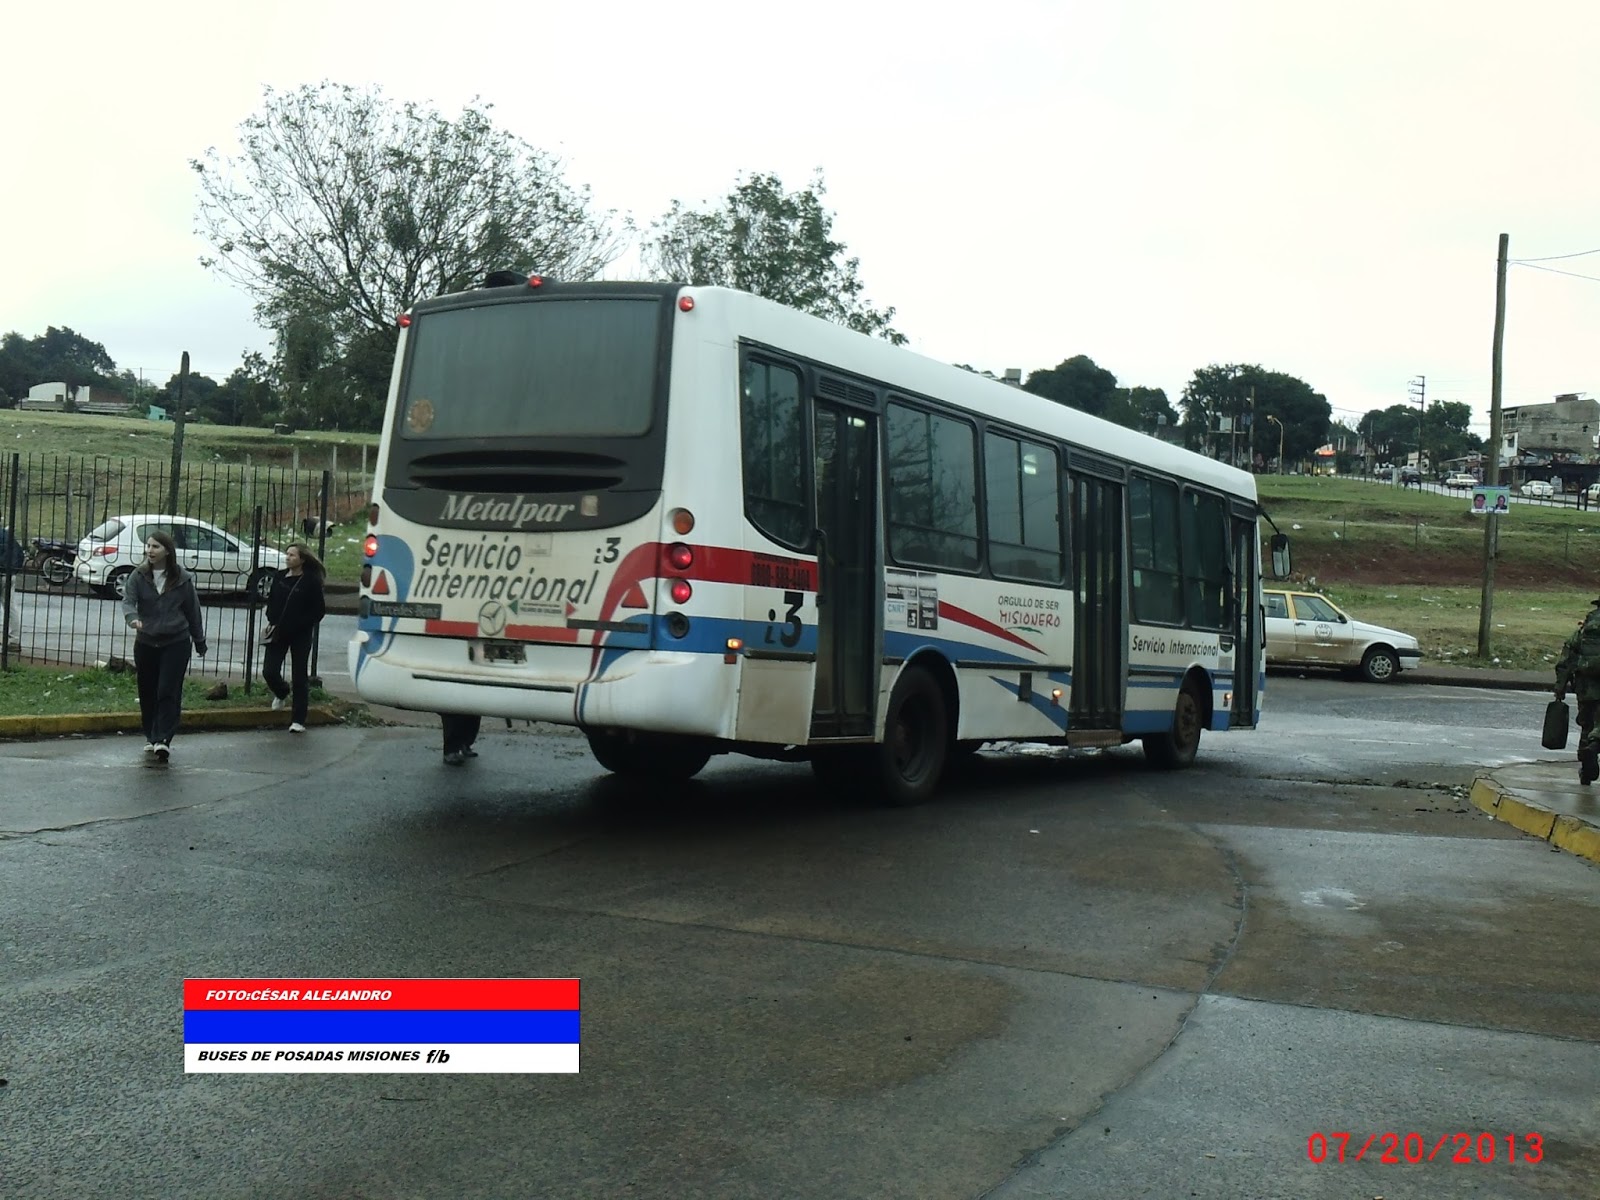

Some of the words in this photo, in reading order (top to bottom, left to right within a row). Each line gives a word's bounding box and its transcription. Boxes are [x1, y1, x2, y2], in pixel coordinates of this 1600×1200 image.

[440, 494, 576, 529] Metalpar
[421, 533, 522, 571] Servicio
[413, 567, 599, 605] Internacional
[998, 595, 1033, 608] ORGULLO
[1034, 599, 1045, 609] DE
[1045, 600, 1060, 610] SER
[999, 610, 1061, 628] MISIONERO
[1132, 635, 1166, 655] Servicio
[1168, 639, 1219, 657] Internacional
